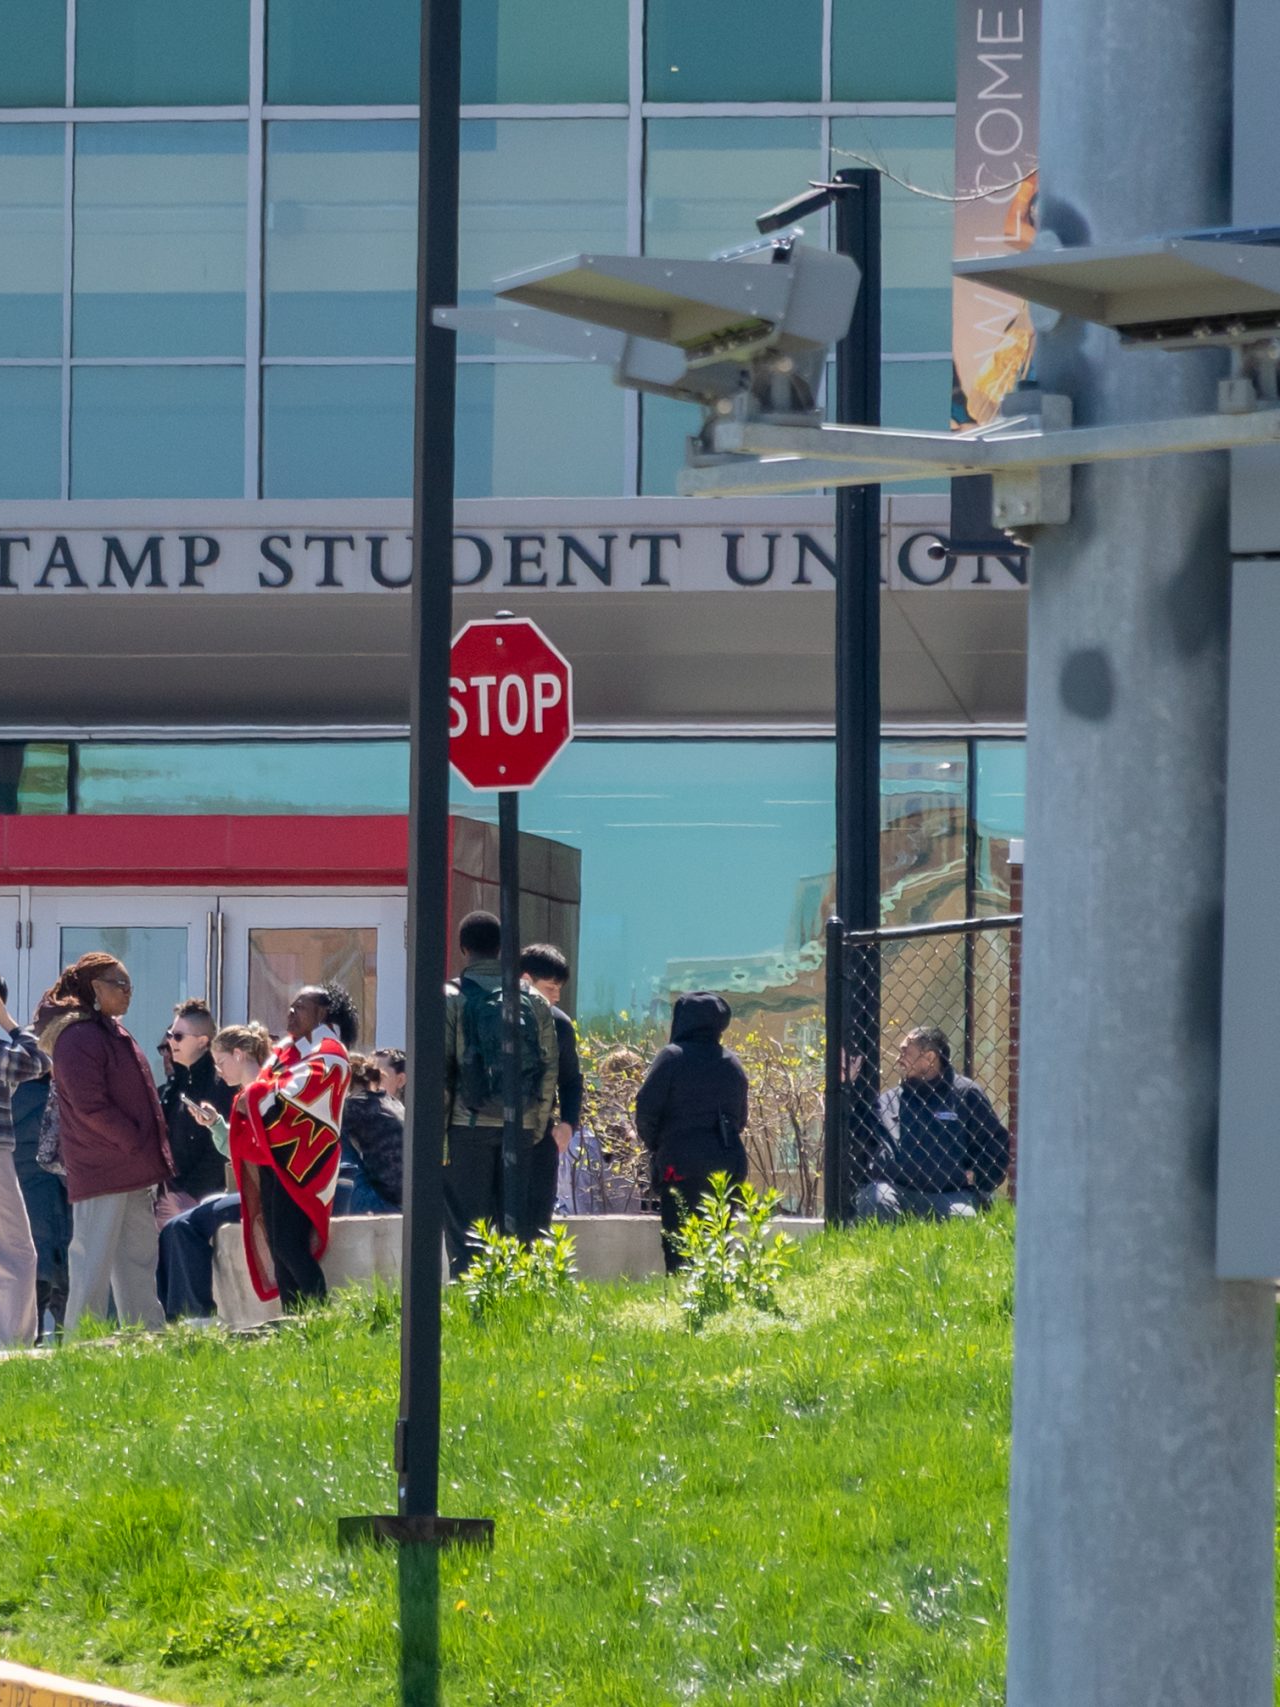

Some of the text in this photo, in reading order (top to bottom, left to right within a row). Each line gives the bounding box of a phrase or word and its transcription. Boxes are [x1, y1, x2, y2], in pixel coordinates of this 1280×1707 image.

[974, 8, 1025, 360] WLCOME
[257, 533, 682, 590] STUDENT
[724, 531, 1028, 587] UNON
[449, 673, 562, 738] STOP
